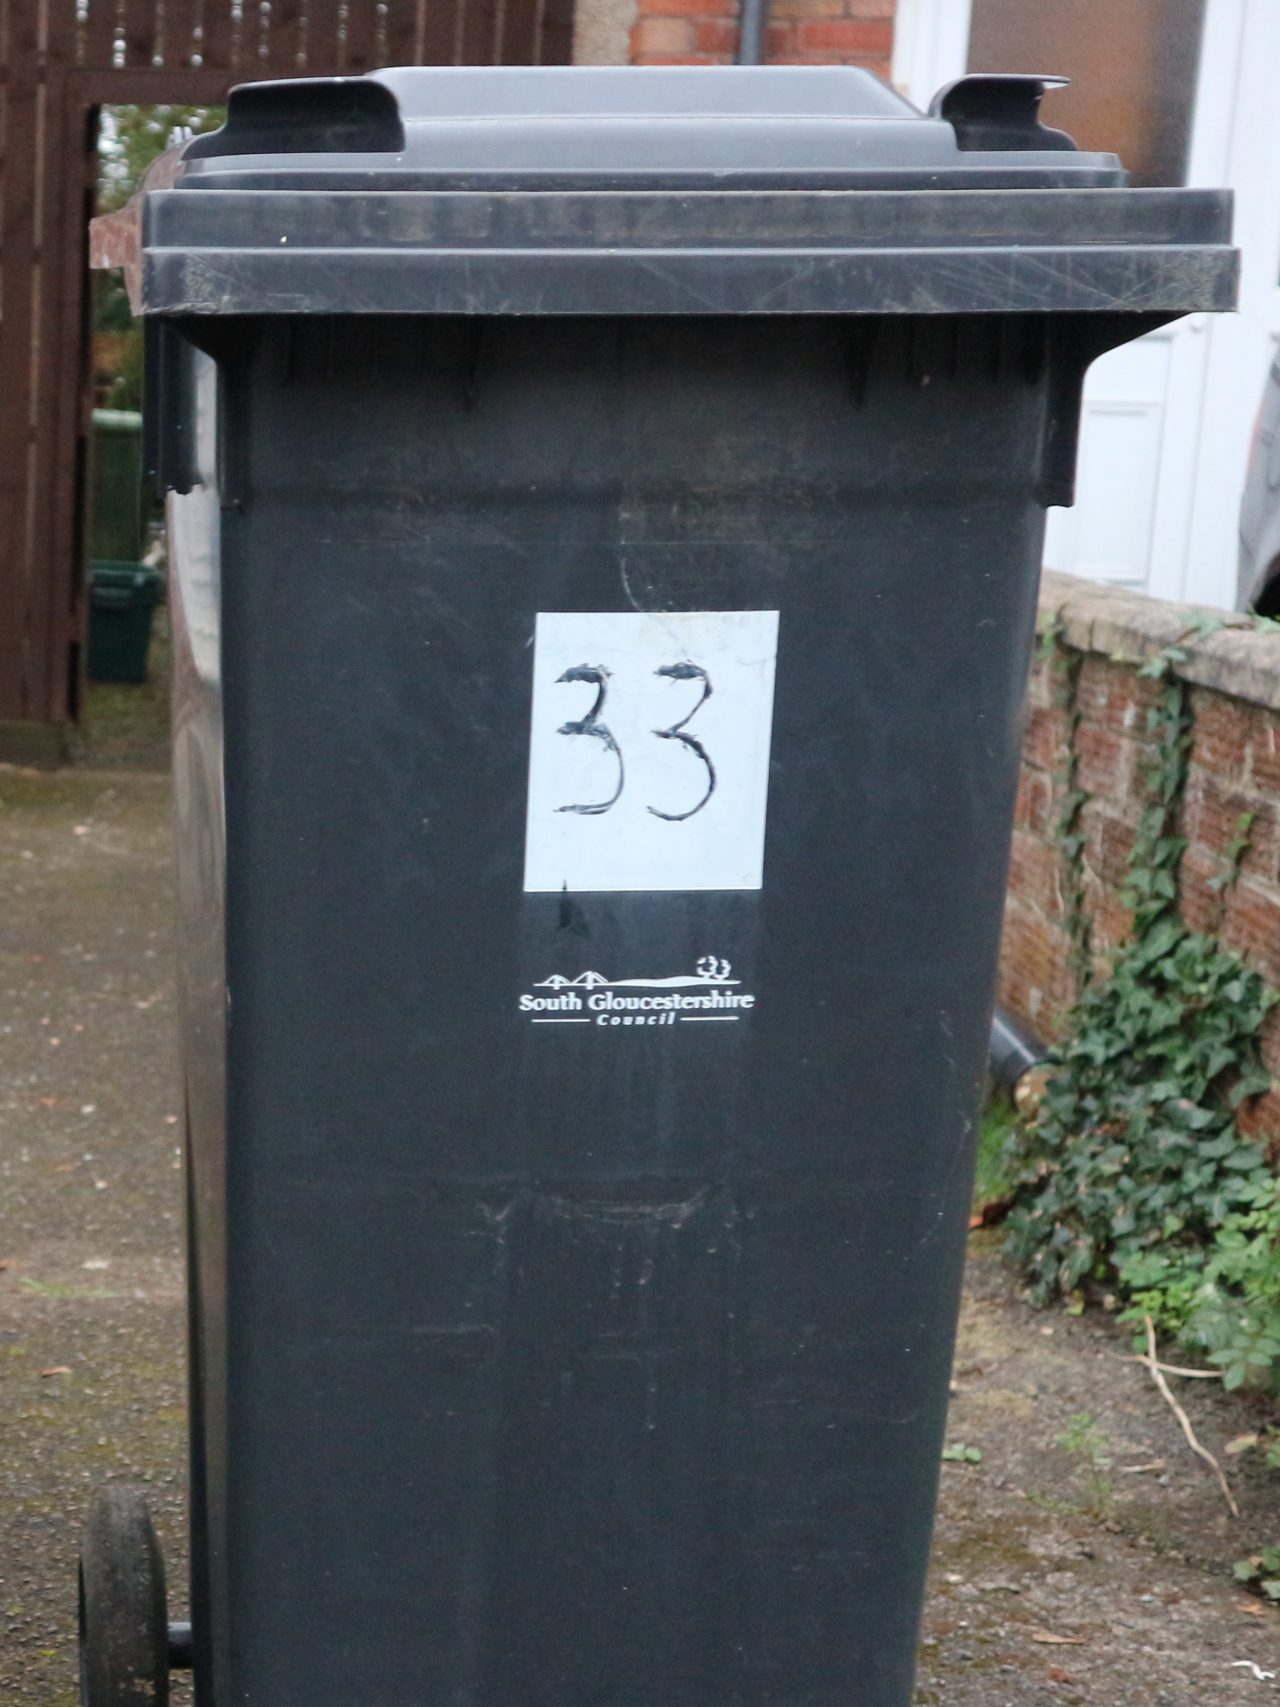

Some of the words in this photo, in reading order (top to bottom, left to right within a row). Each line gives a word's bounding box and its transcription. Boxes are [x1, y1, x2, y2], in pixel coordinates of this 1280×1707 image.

[553, 659, 716, 821] 33
[519, 992, 582, 1011] South
[588, 990, 756, 1011] Gloucestershire
[596, 1012, 676, 1025] Council
